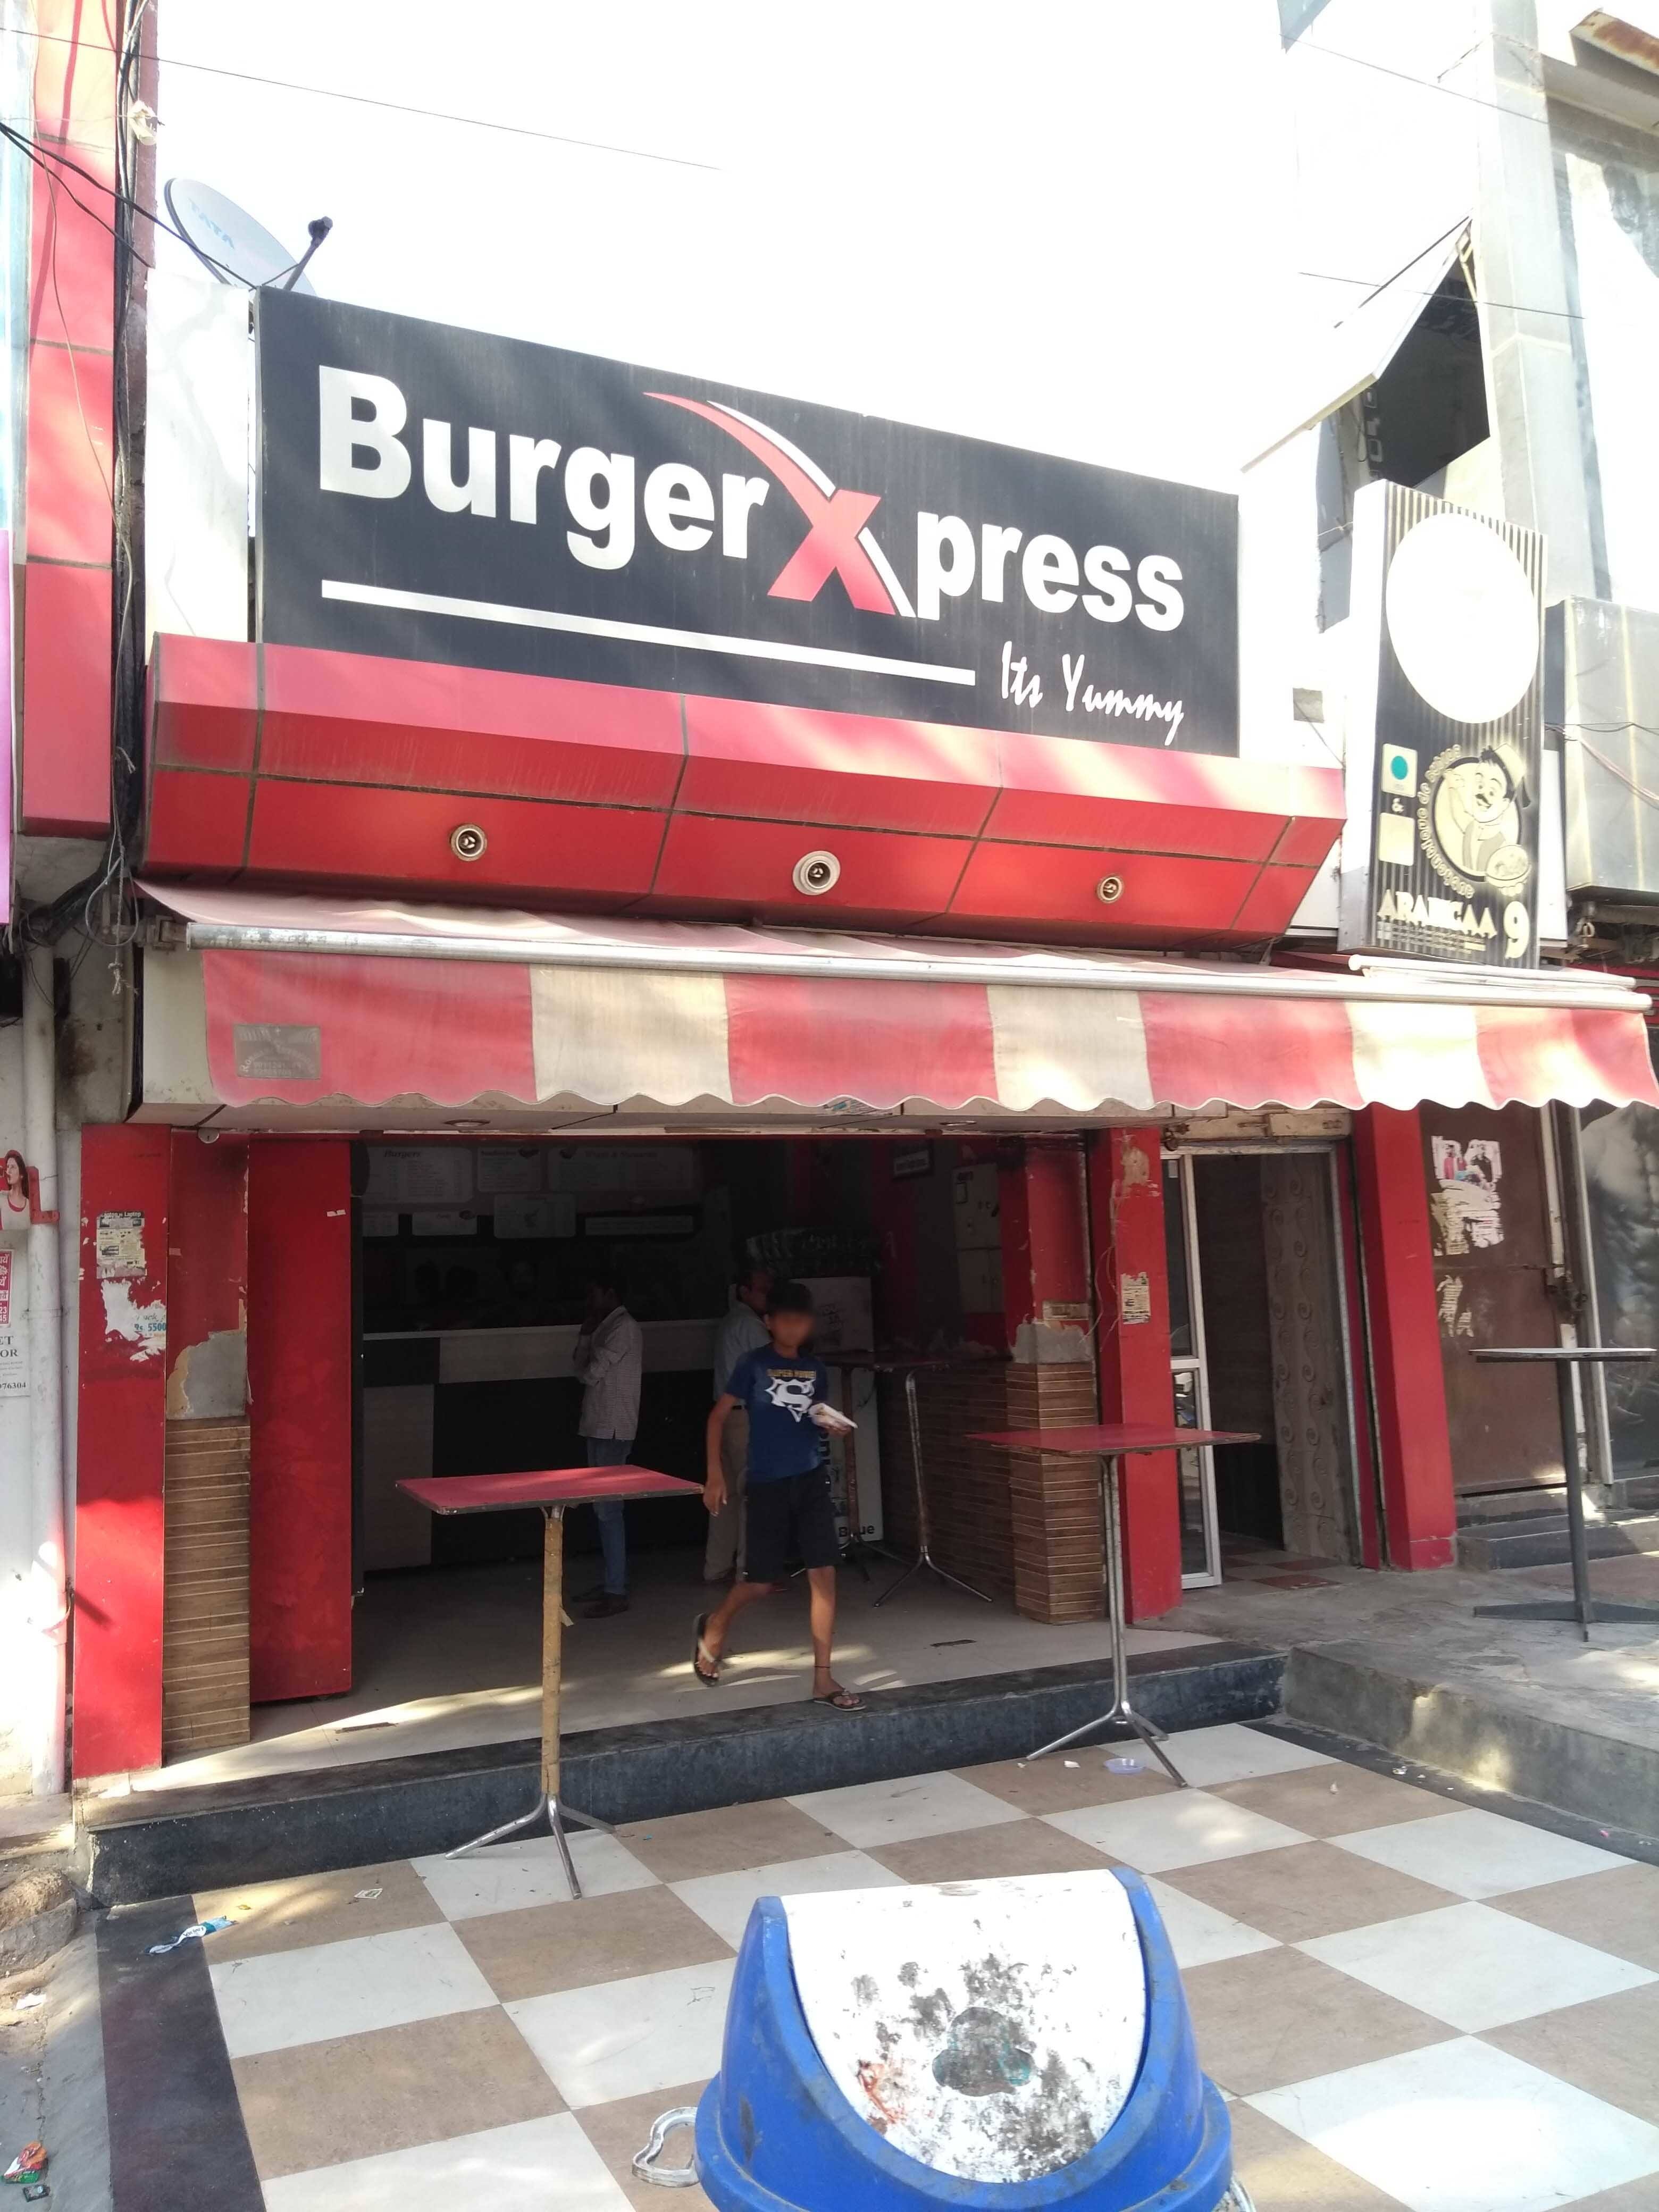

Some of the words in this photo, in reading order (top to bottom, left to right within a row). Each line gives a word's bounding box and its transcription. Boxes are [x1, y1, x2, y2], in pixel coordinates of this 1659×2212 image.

[319, 364, 769, 571] Burger
[1001, 641, 1043, 708] Its
[1062, 653, 1184, 746] Yummy
[1392, 798, 1405, 813] &
[1503, 901, 1530, 959] 9
[384, 1149, 422, 1159] Burgers
[148, 1322, 166, 1332] 5500
[838, 1524, 875, 1538] Bue
